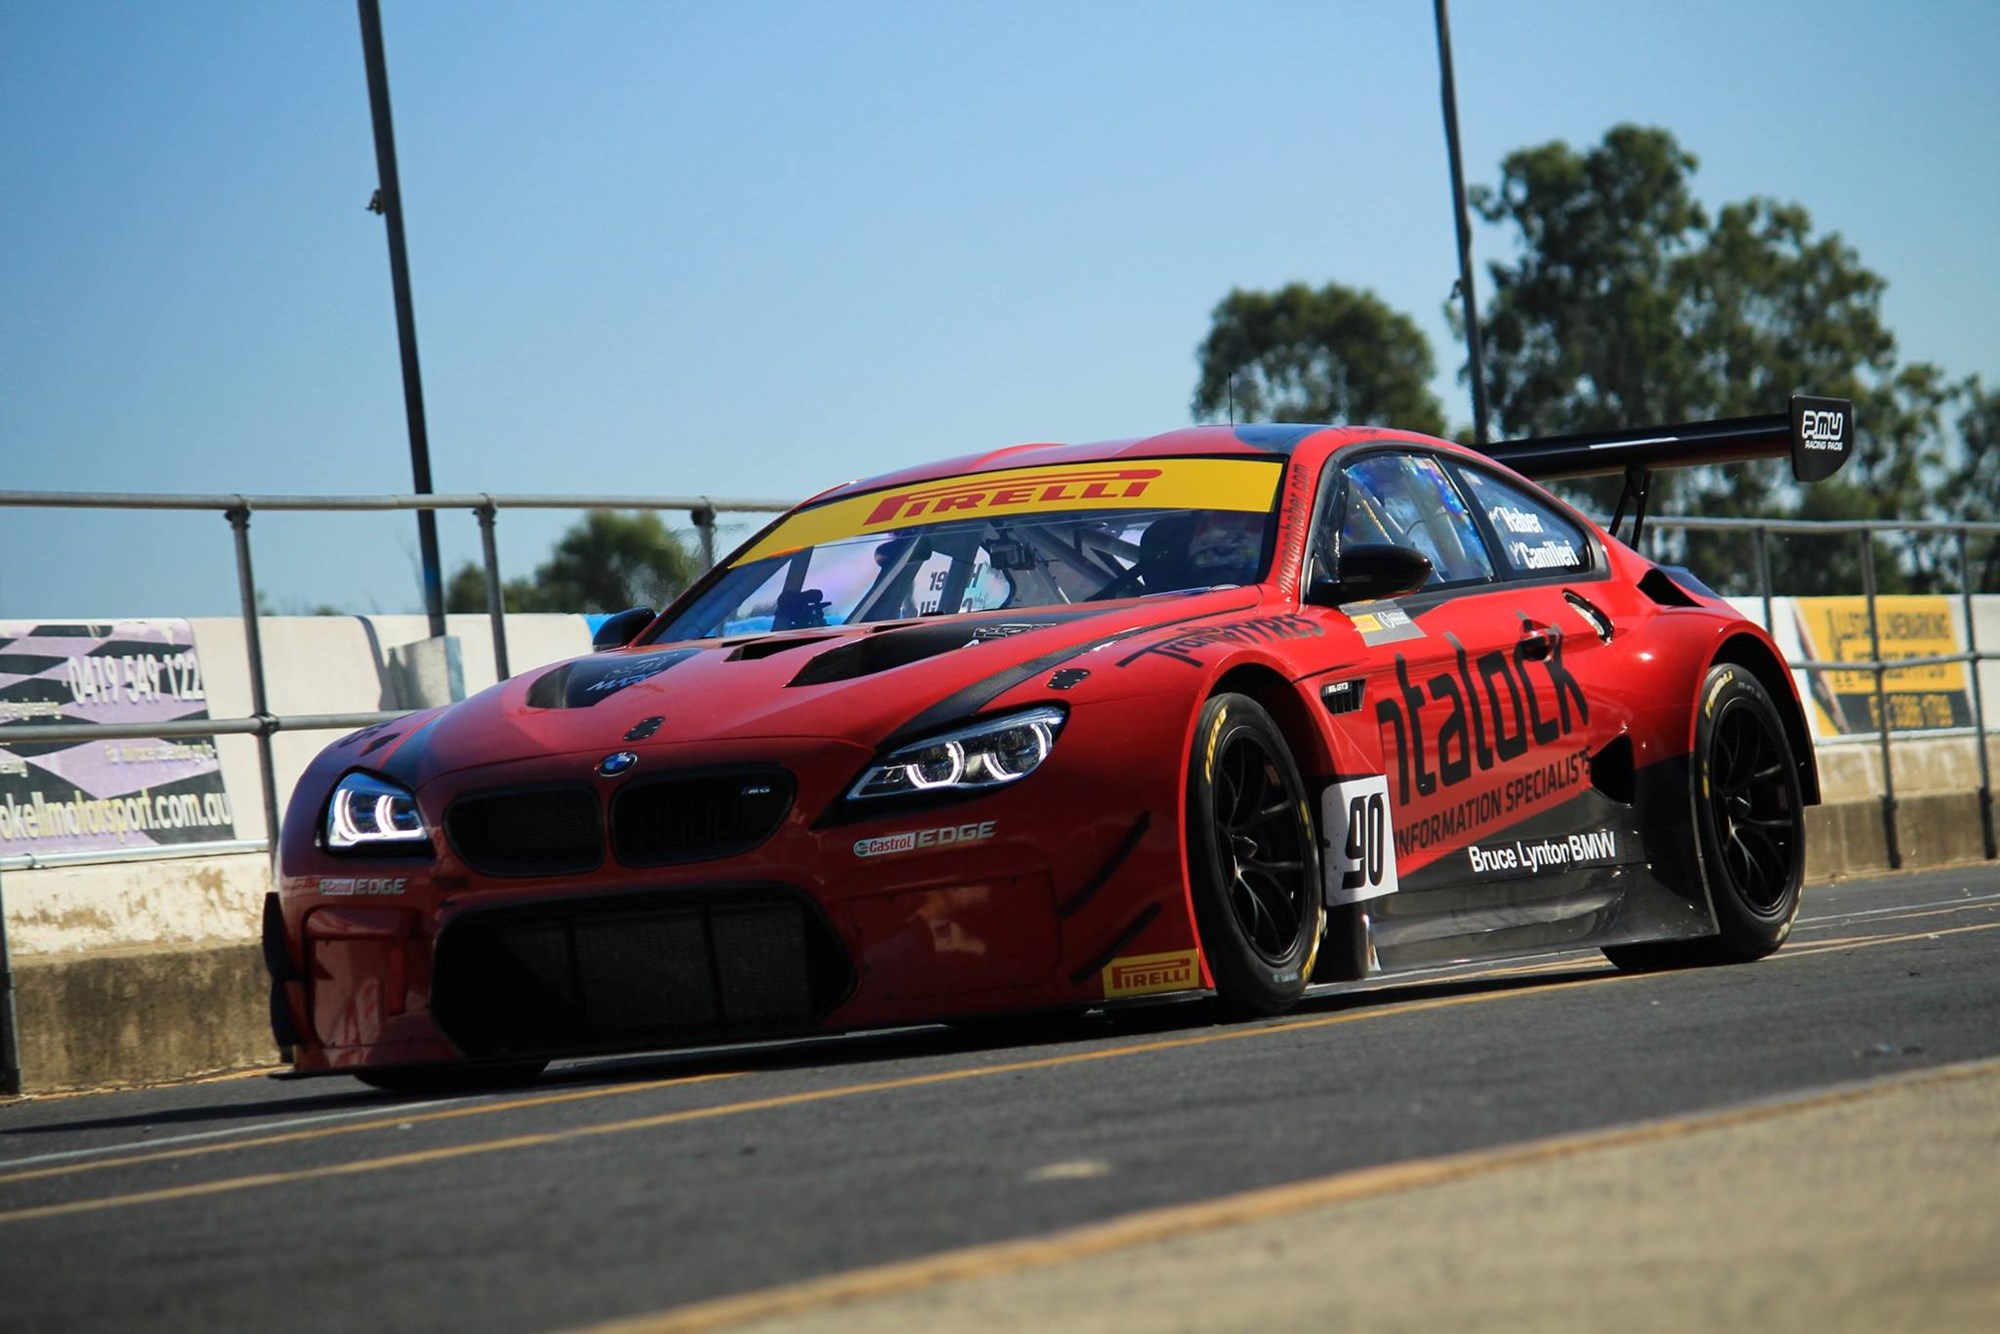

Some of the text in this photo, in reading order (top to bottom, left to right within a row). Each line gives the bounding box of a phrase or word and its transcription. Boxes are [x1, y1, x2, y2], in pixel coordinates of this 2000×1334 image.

[863, 469, 1162, 526] PIRELLI
[1499, 506, 1544, 533] Haber
[1519, 540, 1580, 569] Camilleri
[163, 653, 206, 700] 122
[868, 820, 997, 854] Castrol EDGE
[1342, 792, 1385, 891] 90
[1469, 830, 1616, 873] Bruce Lynton BMW
[355, 878, 407, 894] EDGE
[1112, 958, 1191, 989] PIRELLI
